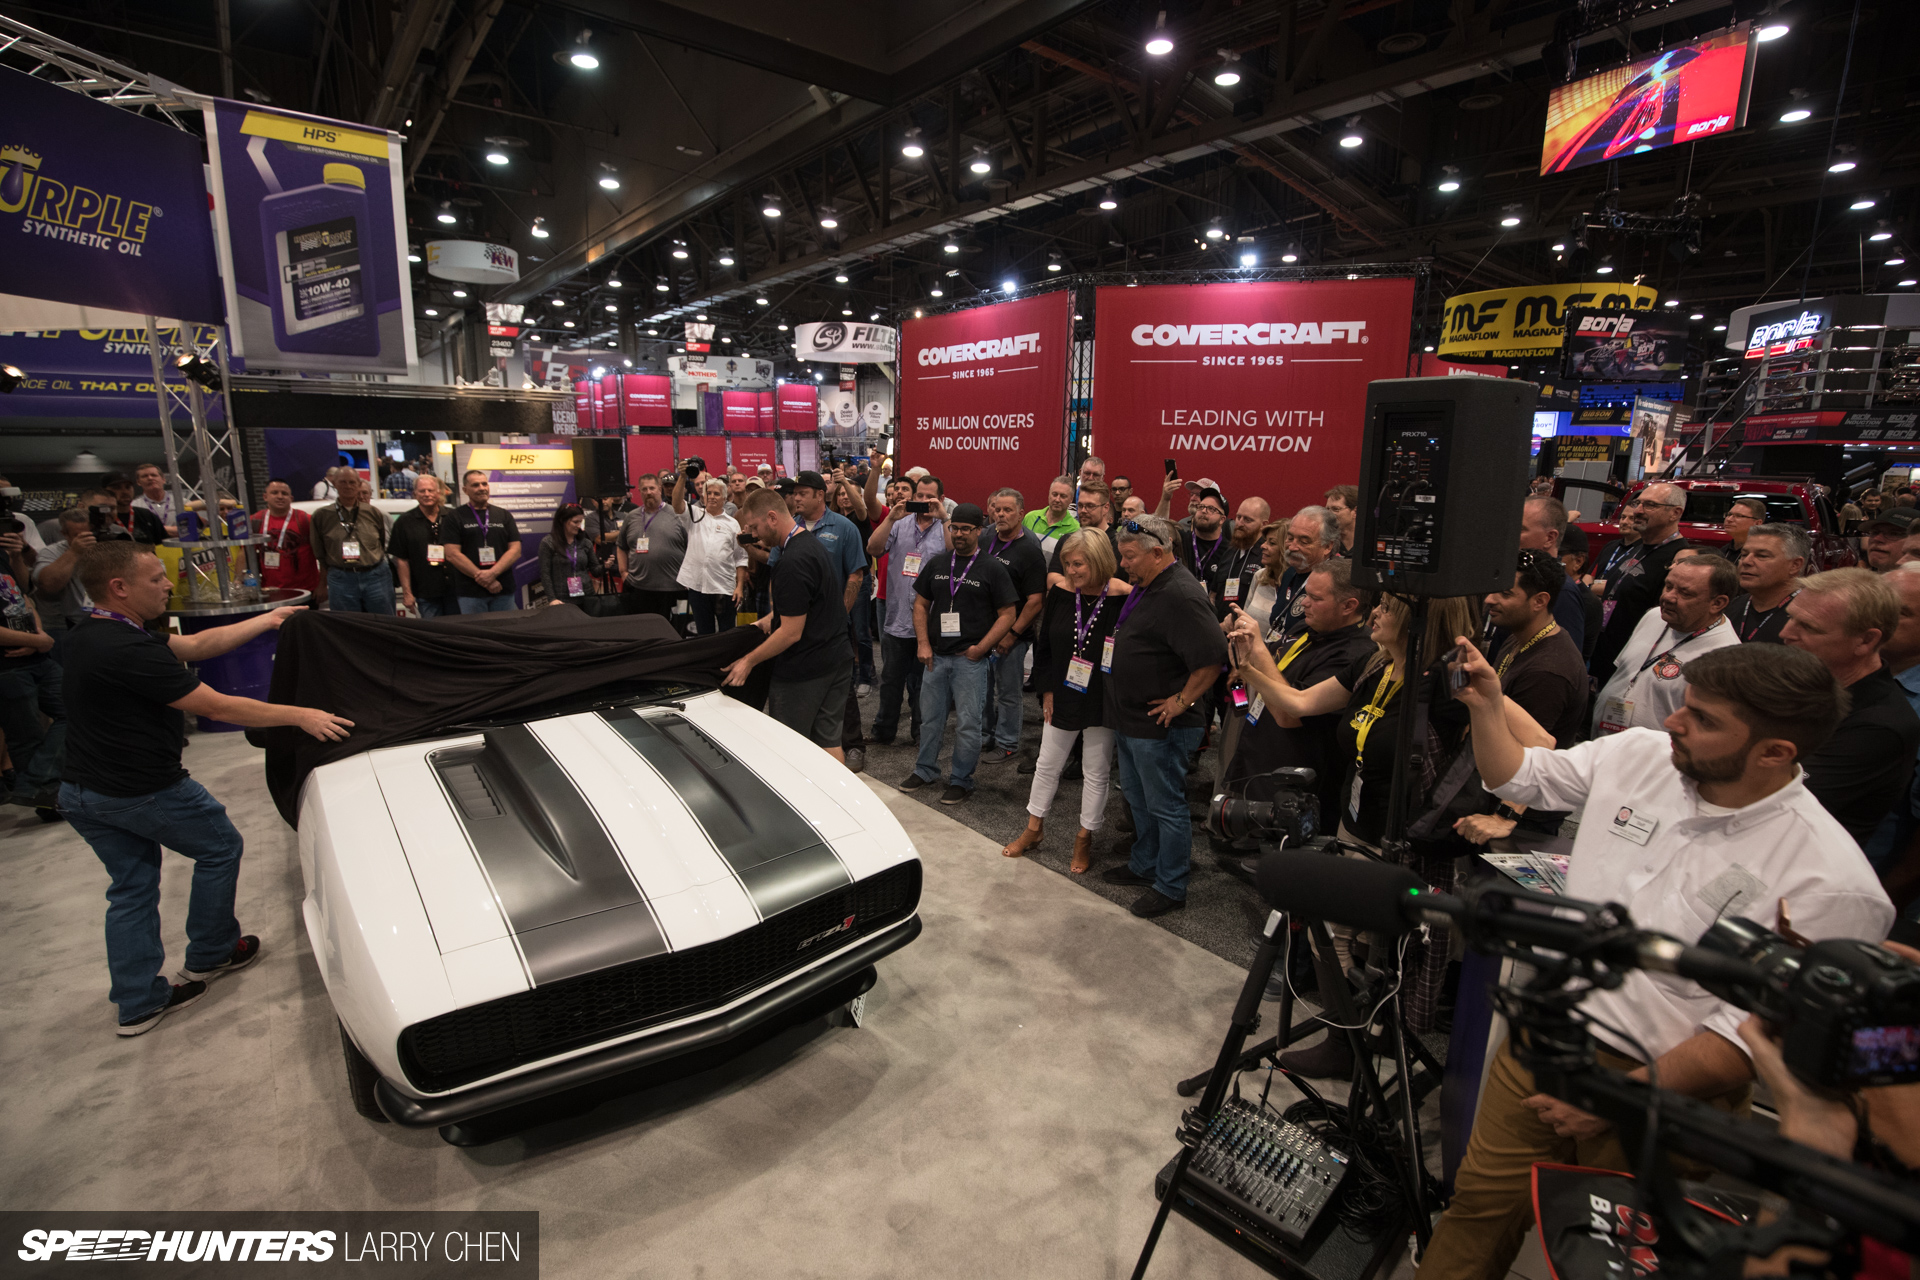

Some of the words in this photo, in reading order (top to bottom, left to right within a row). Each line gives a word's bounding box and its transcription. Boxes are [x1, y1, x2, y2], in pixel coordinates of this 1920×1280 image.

[303, 127, 336, 143] HPS
[22, 220, 112, 250] SYNTHETIC
[118, 240, 142, 256] OIL
[307, 277, 350, 296] 10W-40
[853, 327, 896, 345] FILTE
[1131, 321, 1366, 347] COVERCRAFT
[1449, 331, 1500, 344] MAGNAFLOW
[1513, 327, 1565, 339] MAGNAF
[918, 332, 1040, 367] COVERCRAFT
[1492, 348, 1555, 358] MAGNAFLOW
[1202, 356, 1245, 366] SINCE
[1250, 355, 1284, 366] 1965
[952, 369, 975, 380] SINCE
[976, 367, 995, 378] 1965
[52, 380, 73, 390] OIL
[80, 381, 131, 391] THAT
[916, 417, 930, 431] 35
[932, 415, 980, 430] MILLION
[983, 412, 1035, 429] COVERS
[1161, 409, 1257, 427] LEADING
[1265, 410, 1324, 428] WITH
[929, 436, 953, 450] AND
[956, 435, 1020, 451] COUNTING
[1169, 434, 1312, 453] INNOVATION
[509, 455, 535, 464] HPS
